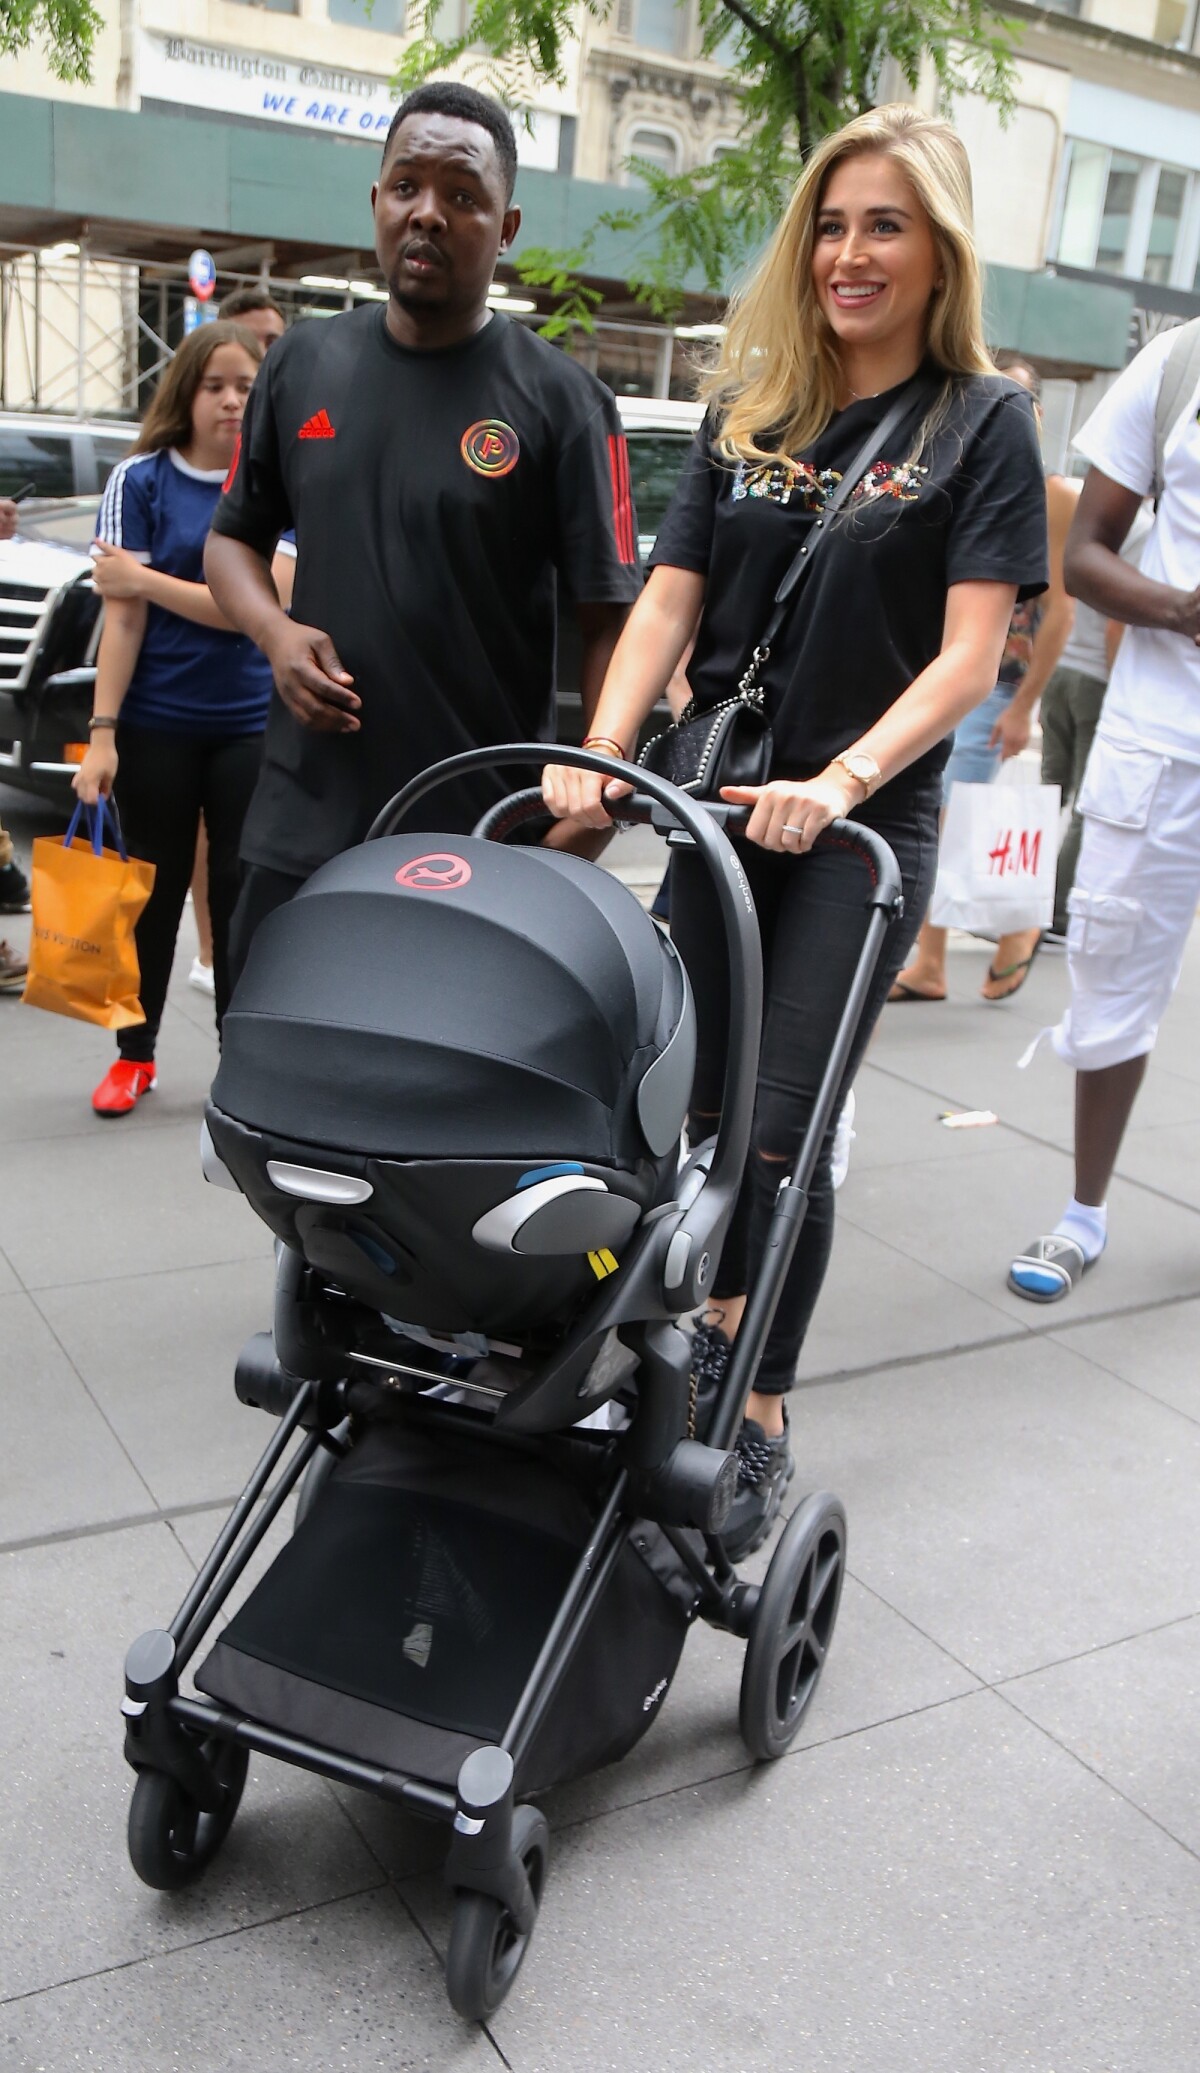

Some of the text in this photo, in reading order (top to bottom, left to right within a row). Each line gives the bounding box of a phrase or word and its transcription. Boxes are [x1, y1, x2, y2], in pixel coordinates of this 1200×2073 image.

[166, 39, 378, 98] Barrington Gallery
[262, 92, 393, 131] WE ARE OP
[988, 827, 1041, 877] H&M
[736, 870, 754, 914] cybex
